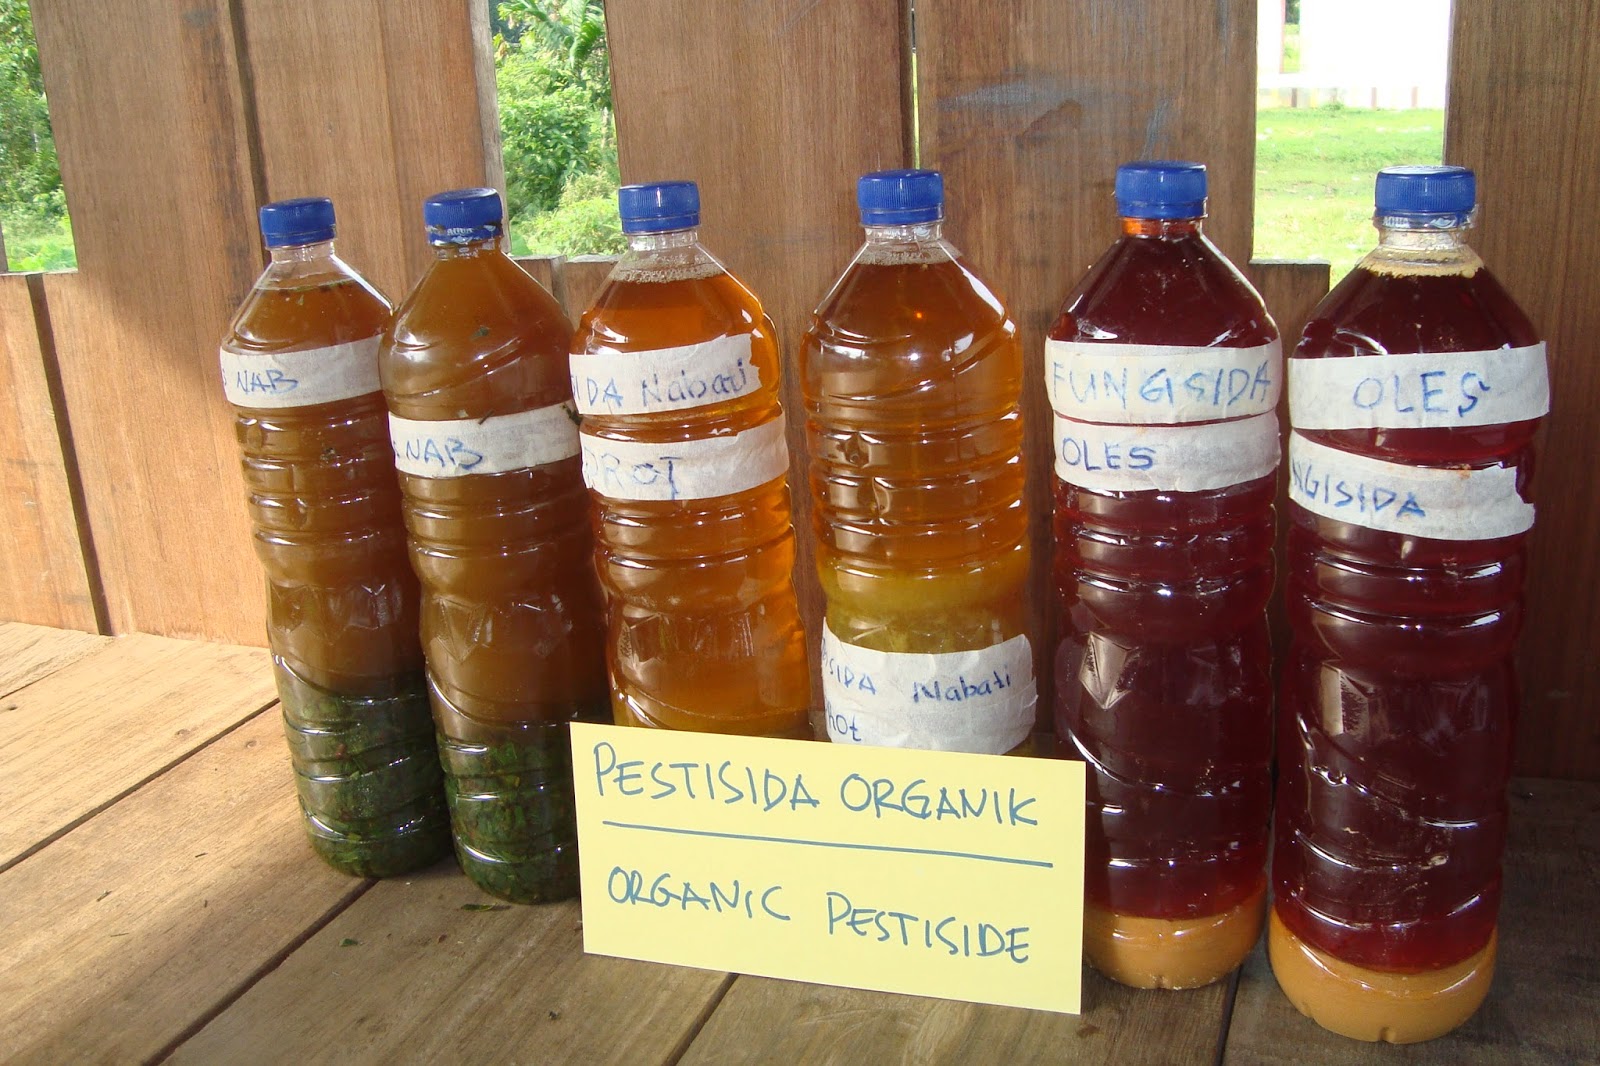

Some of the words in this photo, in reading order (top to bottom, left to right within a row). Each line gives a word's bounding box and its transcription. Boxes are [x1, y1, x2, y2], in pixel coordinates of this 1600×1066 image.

[236, 369, 299, 395] NAB
[1053, 360, 1272, 409] FUNGISIDA
[1352, 370, 1492, 418] OLES
[405, 436, 485, 471] NAB
[1062, 437, 1157, 472] OLES
[913, 664, 1012, 703] Nabati
[593, 740, 821, 813] PESTISIDA
[839, 772, 1039, 826] ORGANIK
[607, 865, 791, 922] ORGANIC
[825, 890, 1031, 965] PESTISIDE
